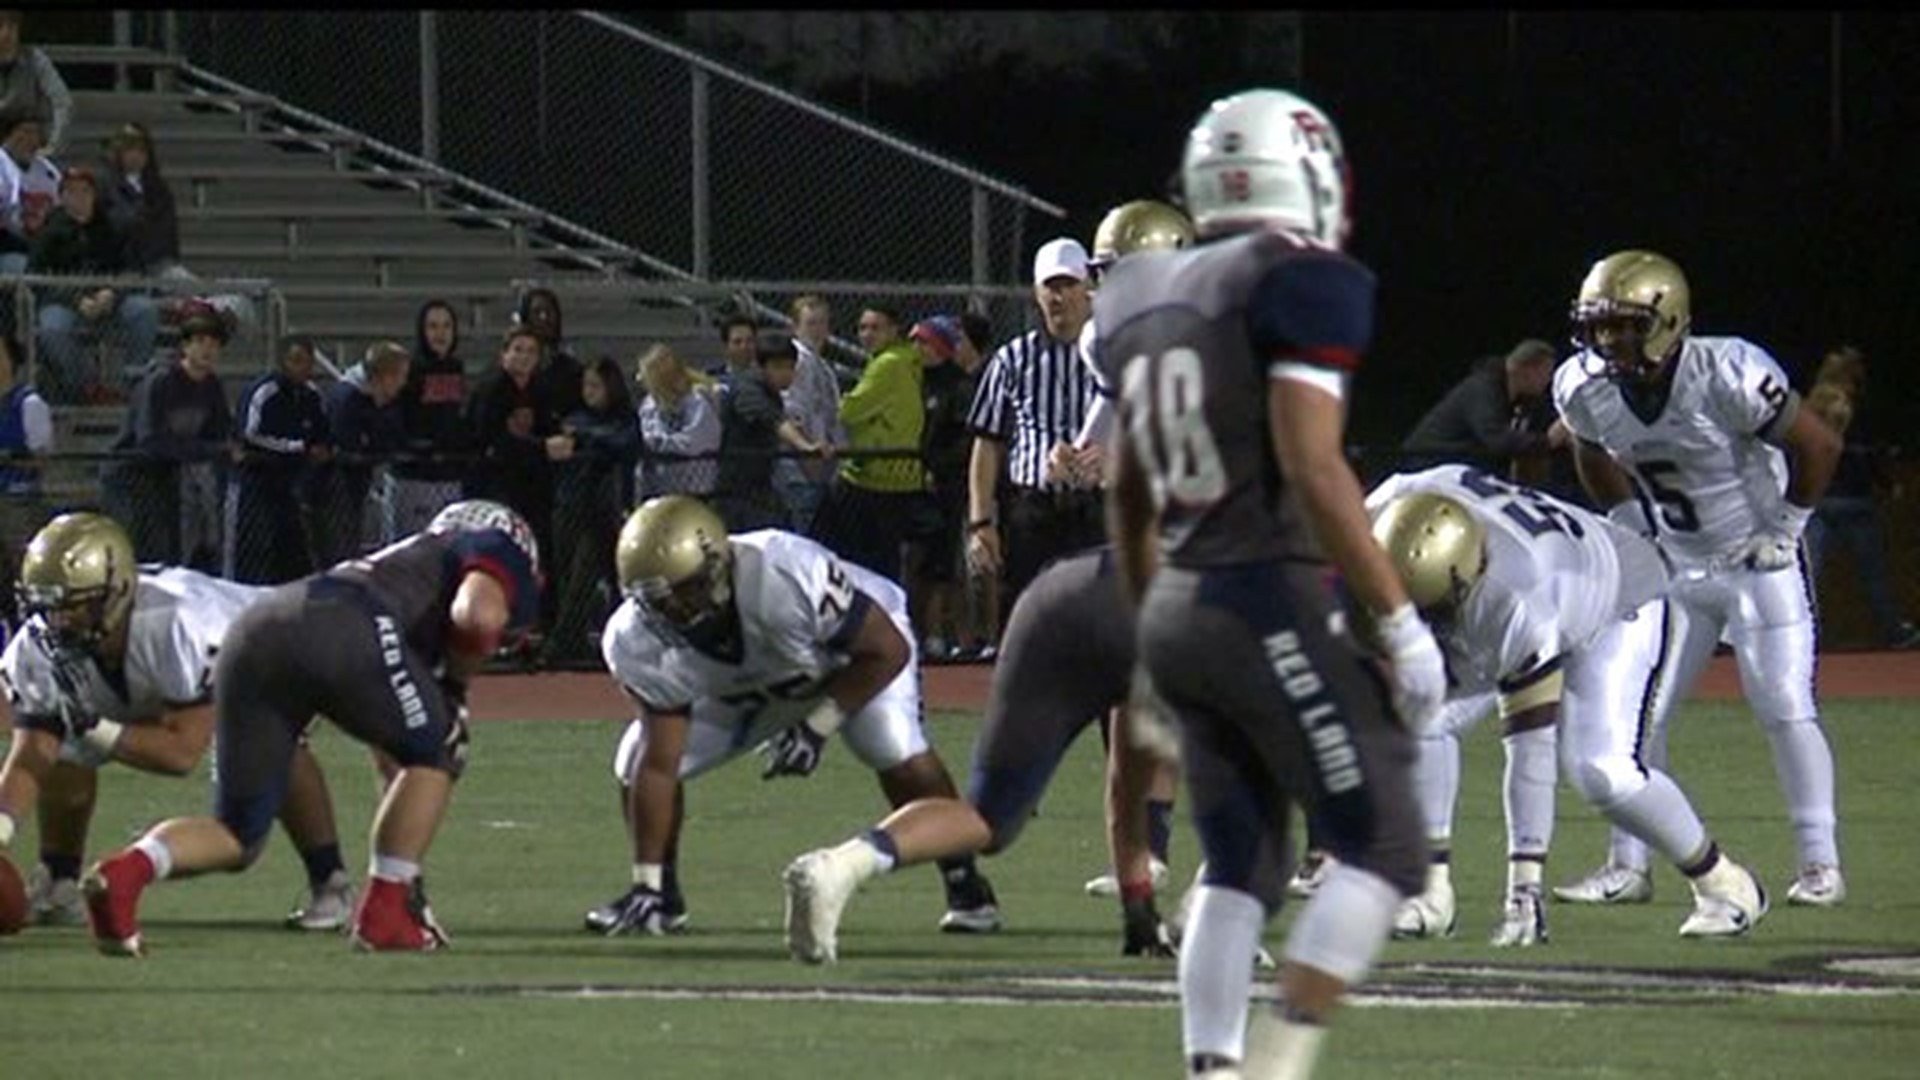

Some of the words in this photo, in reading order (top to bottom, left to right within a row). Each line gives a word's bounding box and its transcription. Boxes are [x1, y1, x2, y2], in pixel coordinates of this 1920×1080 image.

[1120, 347, 1230, 508] 18
[1758, 374, 1788, 410] 5
[818, 560, 852, 621] 75
[375, 615, 402, 667] RED
[390, 669, 428, 729] LAND
[1262, 630, 1323, 699] RED
[1300, 703, 1363, 793] LAND
